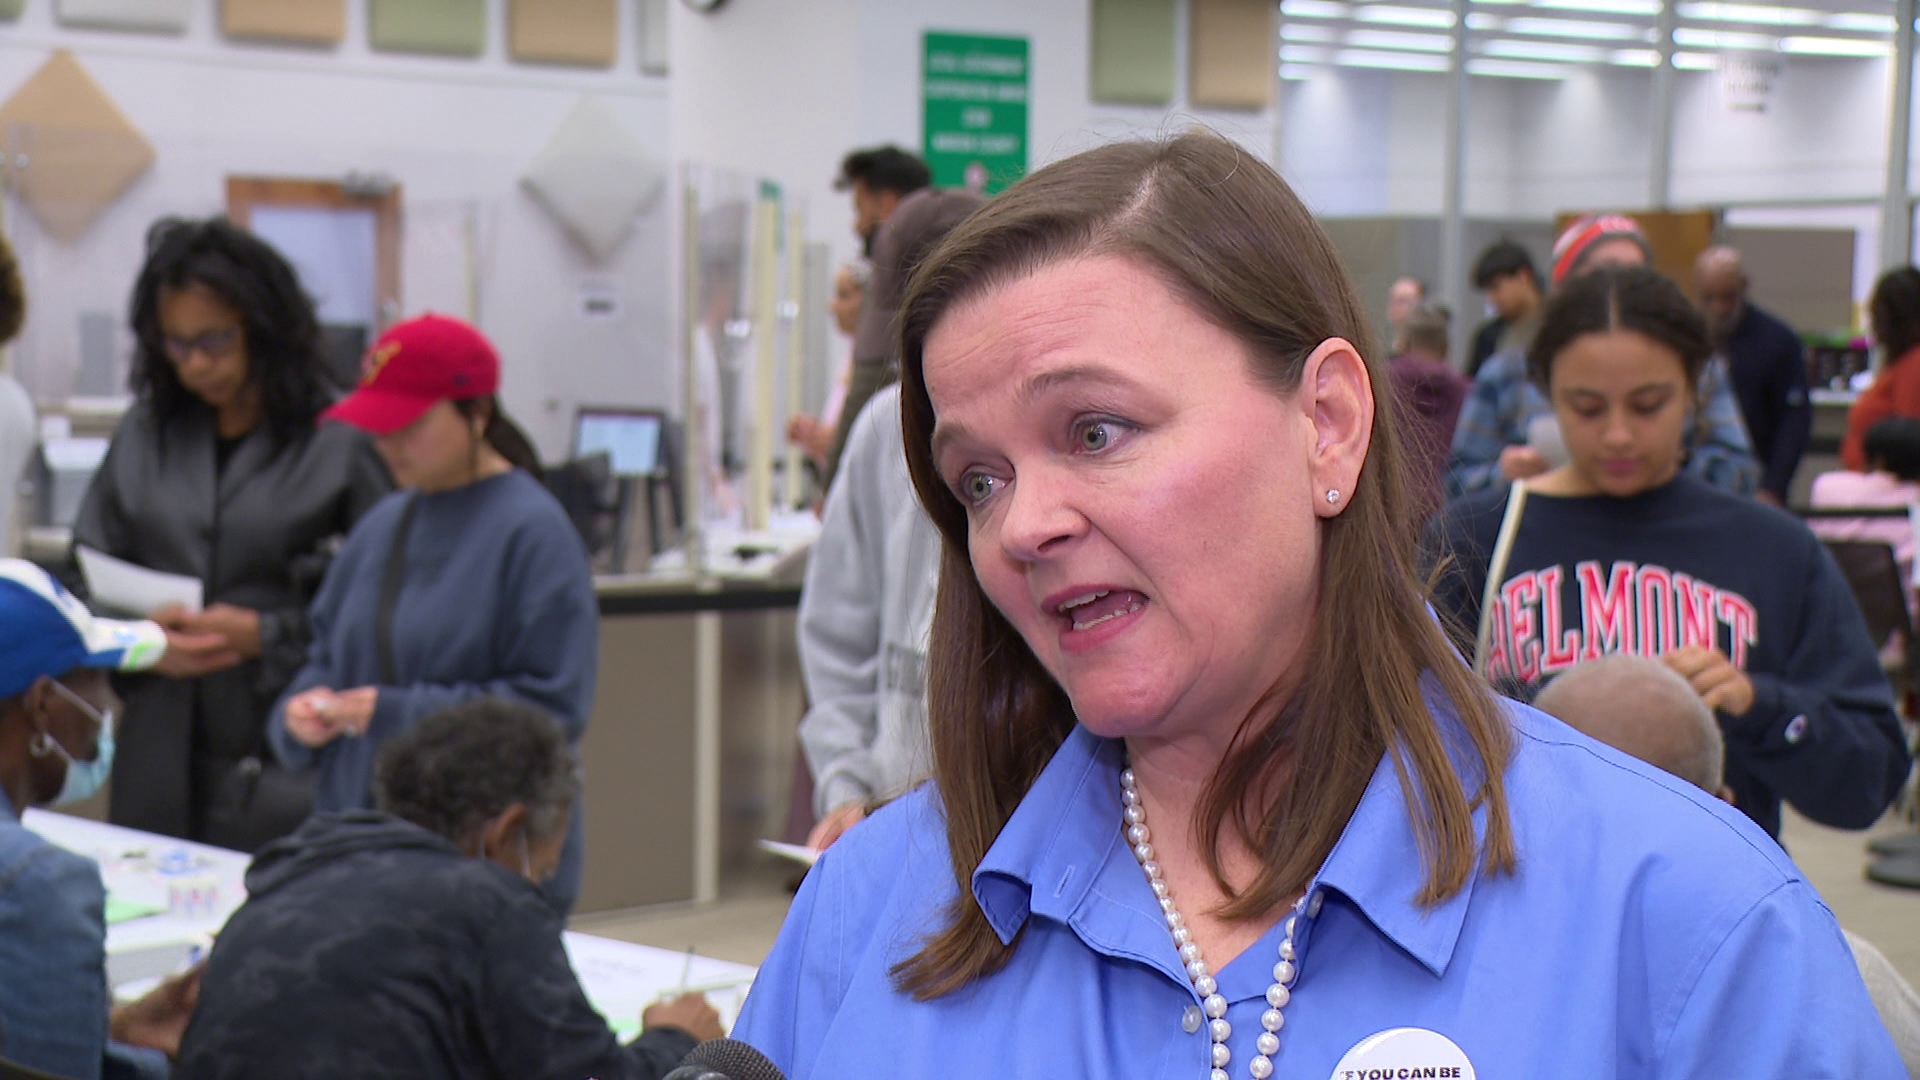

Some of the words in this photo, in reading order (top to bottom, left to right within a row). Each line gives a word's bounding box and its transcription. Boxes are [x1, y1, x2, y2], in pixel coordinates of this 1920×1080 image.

[1356, 1069, 1394, 1080] YOU
[1397, 1067, 1436, 1080] CAN
[1440, 1067, 1461, 1079] BE
